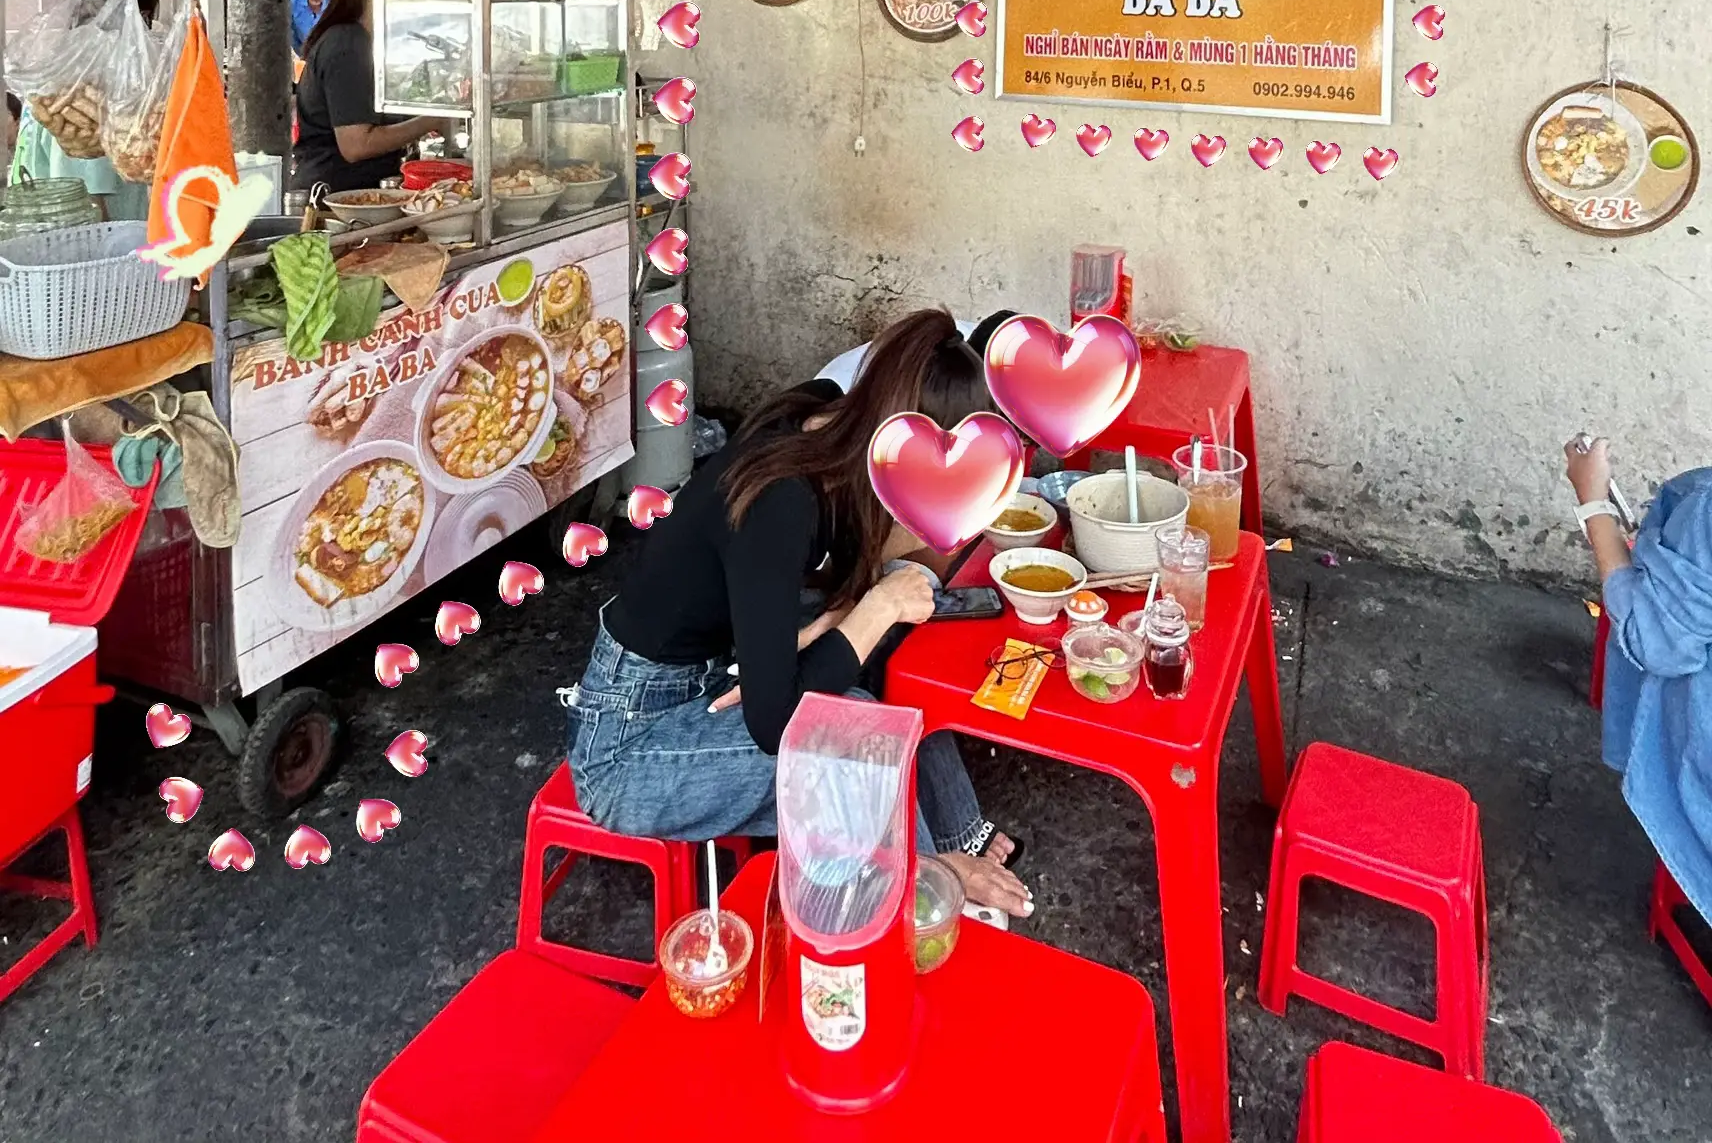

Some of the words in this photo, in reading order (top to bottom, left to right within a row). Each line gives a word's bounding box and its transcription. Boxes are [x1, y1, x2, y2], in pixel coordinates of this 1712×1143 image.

[904, 2, 958, 23] 100k
[1024, 30, 1058, 57] NGHỈ
[1060, 34, 1090, 58] BÁN
[1093, 33, 1132, 60] NGÀY
[1134, 31, 1169, 61] RẰM
[1172, 41, 1186, 62] &
[1188, 36, 1236, 64] MÙNG
[1240, 43, 1249, 64] 1
[1252, 35, 1298, 67] HẰNG
[1300, 41, 1358, 70] THÁNG
[1024, 69, 1052, 86] 84/6
[1055, 70, 1107, 91] Nguyễn
[1111, 72, 1148, 92] Biểu,
[1181, 77, 1206, 94] Q.5
[1253, 82, 1356, 101] 0902.994.946
[1575, 197, 1641, 223] 45k
[359, 304, 444, 353] CANH
[449, 281, 501, 321] CUA
[398, 347, 438, 384] BA
